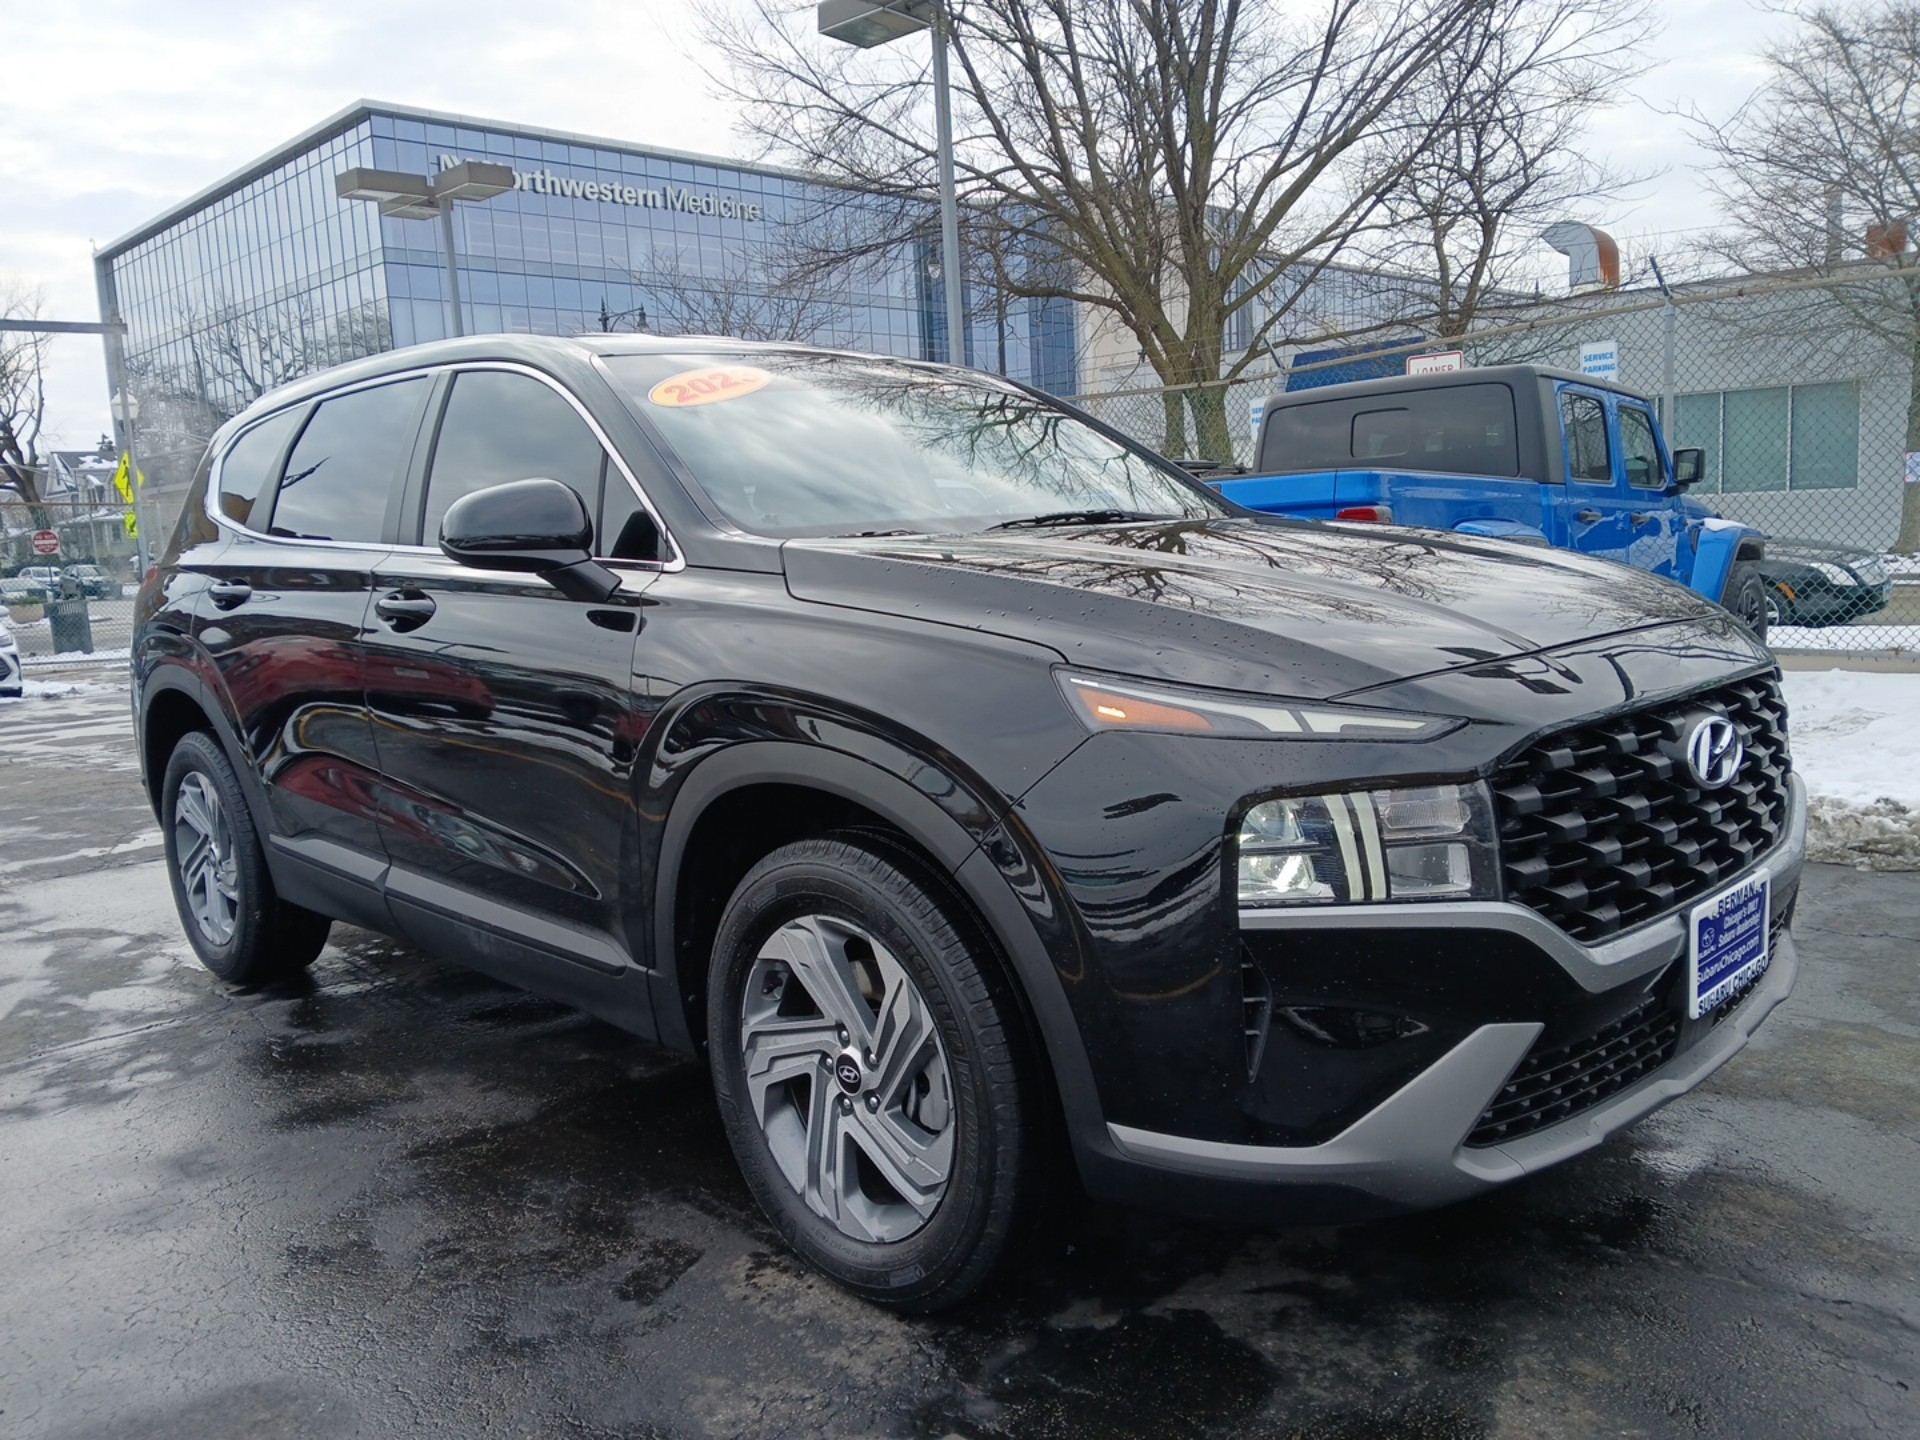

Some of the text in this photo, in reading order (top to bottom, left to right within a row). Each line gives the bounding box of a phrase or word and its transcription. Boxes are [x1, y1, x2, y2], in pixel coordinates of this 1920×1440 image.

[482, 158, 663, 209] orthwestern
[666, 185, 761, 221] Medicine
[1583, 363, 1616, 373] PARKING
[1584, 352, 1615, 362] SERVICE
[663, 372, 759, 403] 202
[1718, 879, 1757, 914] BERMAN
[1698, 955, 1767, 1017] SUBARU CHICAGO
